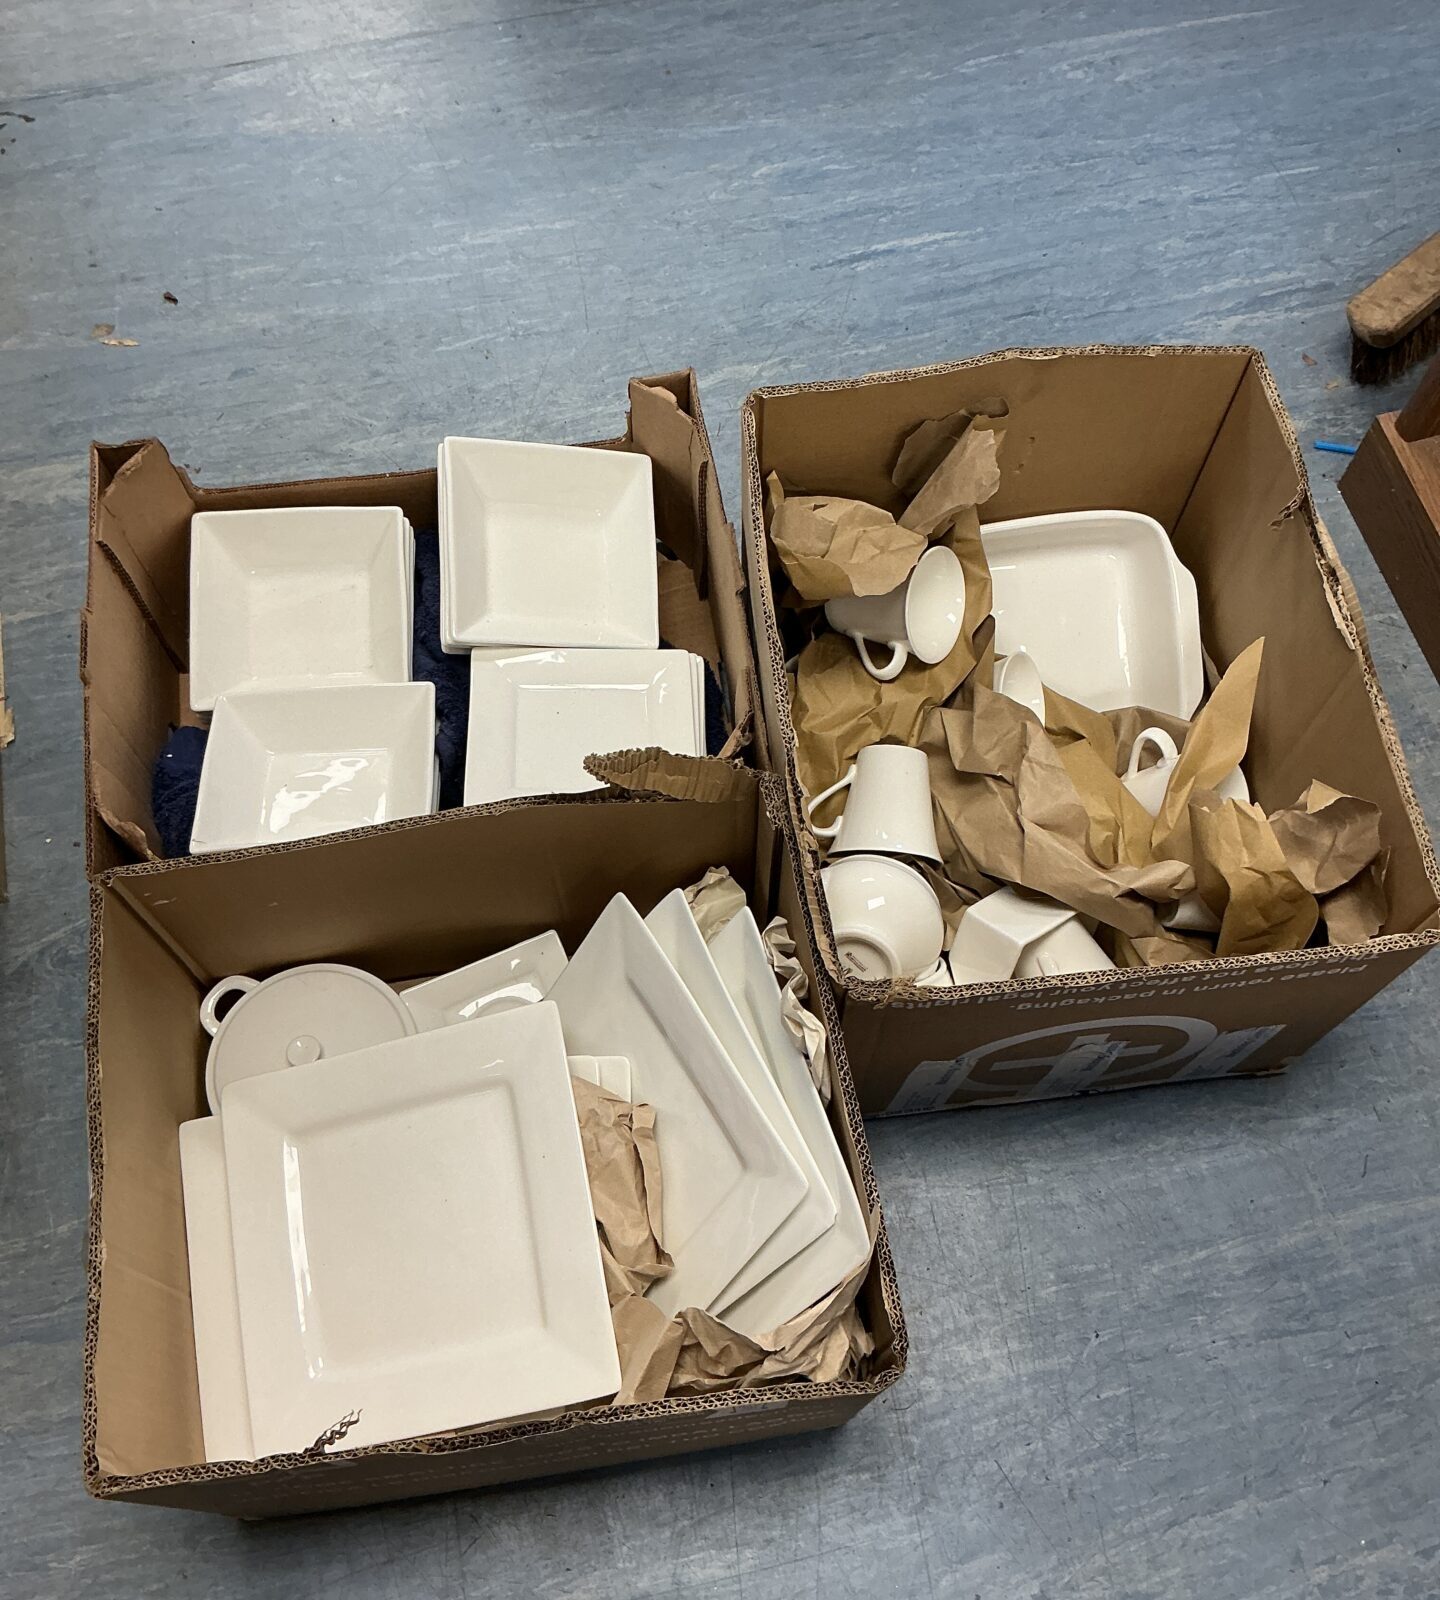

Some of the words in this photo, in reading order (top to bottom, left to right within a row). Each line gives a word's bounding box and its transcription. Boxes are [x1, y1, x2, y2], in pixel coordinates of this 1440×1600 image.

[1254, 960, 1318, 973] does
[1280, 964, 1368, 980] Please
[1202, 969, 1246, 980] not
[1049, 983, 1111, 996] your
[1118, 975, 1196, 990] affect
[1193, 977, 1274, 992] return
[977, 990, 1042, 1004] legal
[1009, 990, 1155, 1010] packaging.
